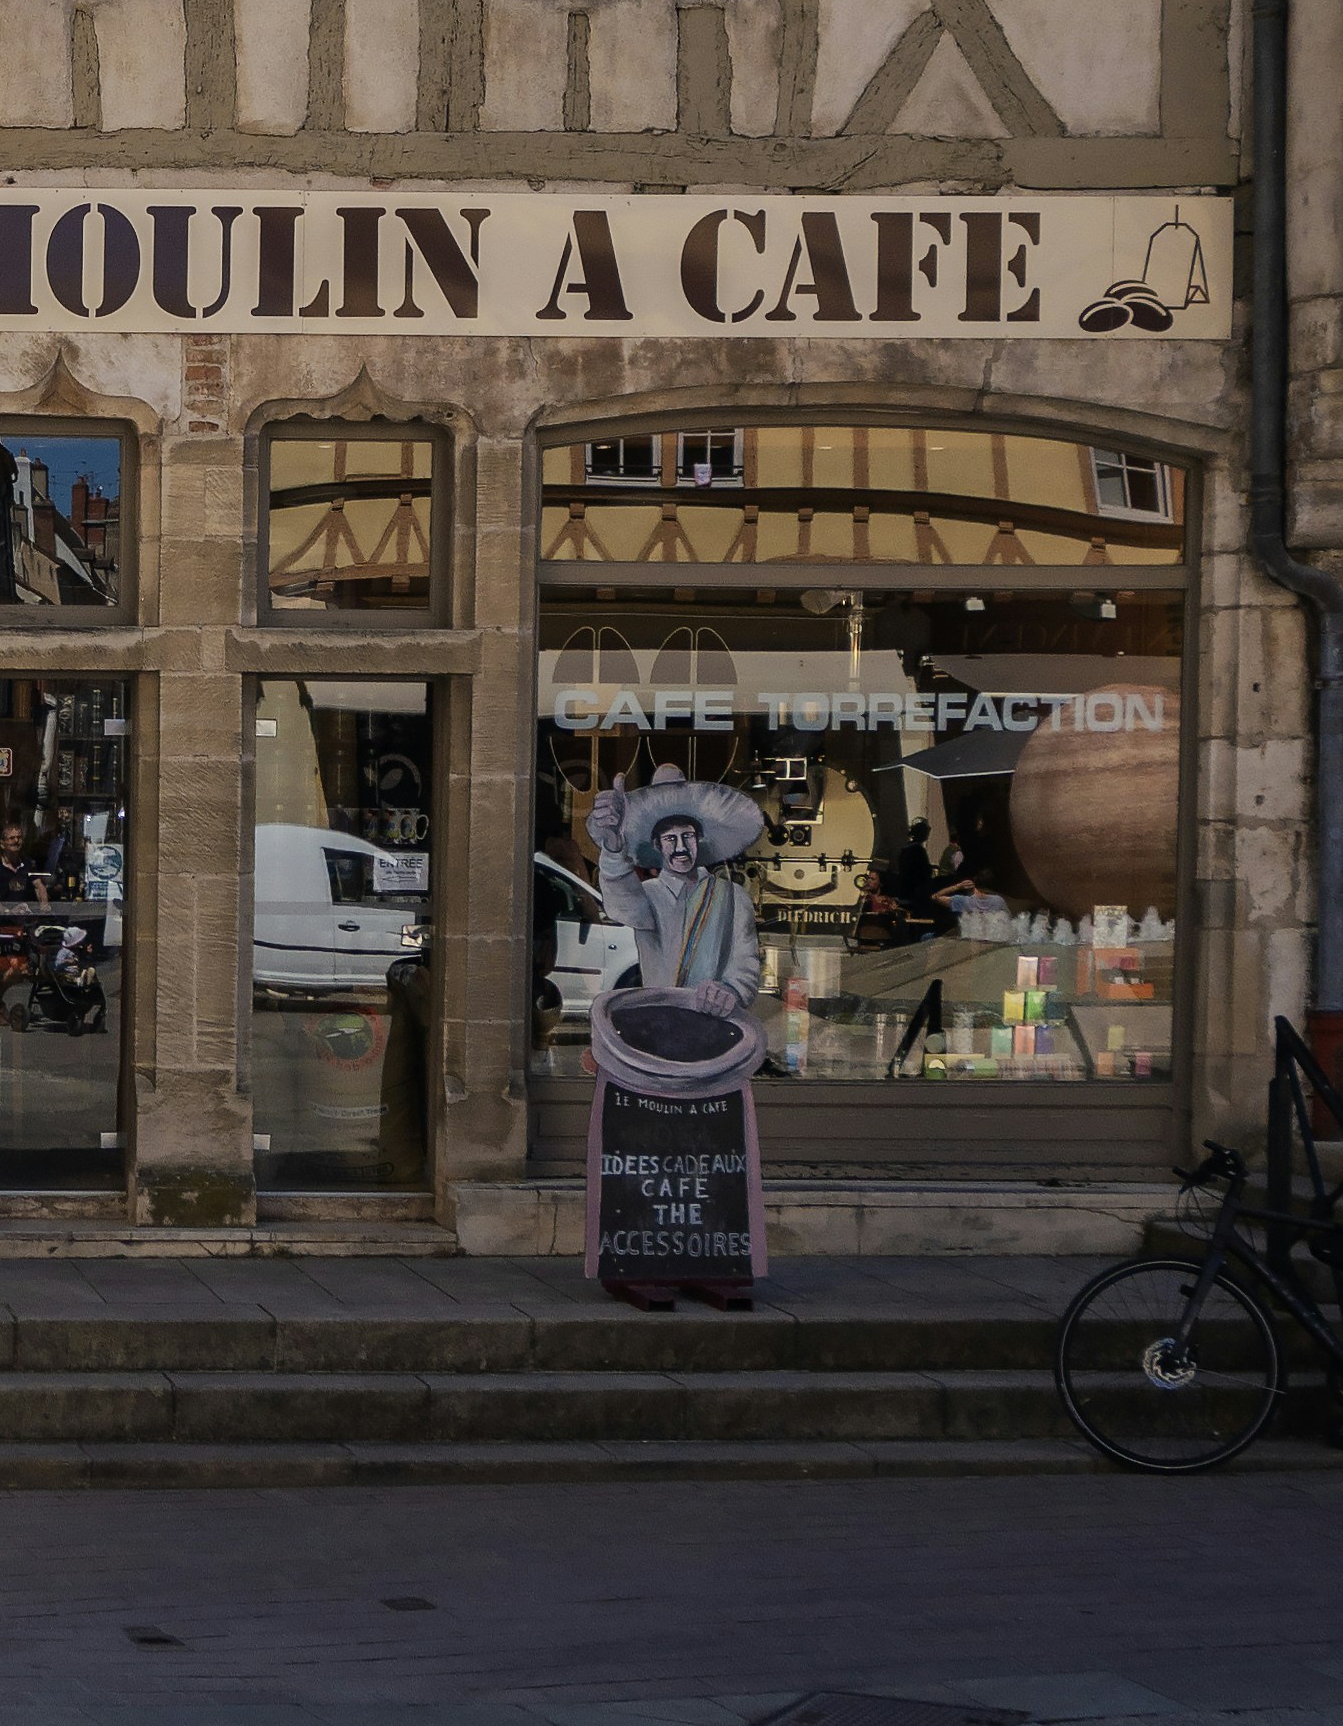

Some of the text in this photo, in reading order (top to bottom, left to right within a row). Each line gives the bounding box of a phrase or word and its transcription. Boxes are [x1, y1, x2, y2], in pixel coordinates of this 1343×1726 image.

[535, 210, 634, 321] A
[680, 208, 1041, 323] CAFE
[553, 690, 1165, 733] CAFE TORREFACTION
[778, 910, 851, 924] DIEDRICH
[615, 1094, 728, 1115] LE MOULIN A CAFE
[601, 1153, 746, 1175] IDEES CADEAUX
[641, 1177, 710, 1198] CAFE
[653, 1202, 704, 1226] THE
[599, 1230, 751, 1257] ACCESSOIRES
